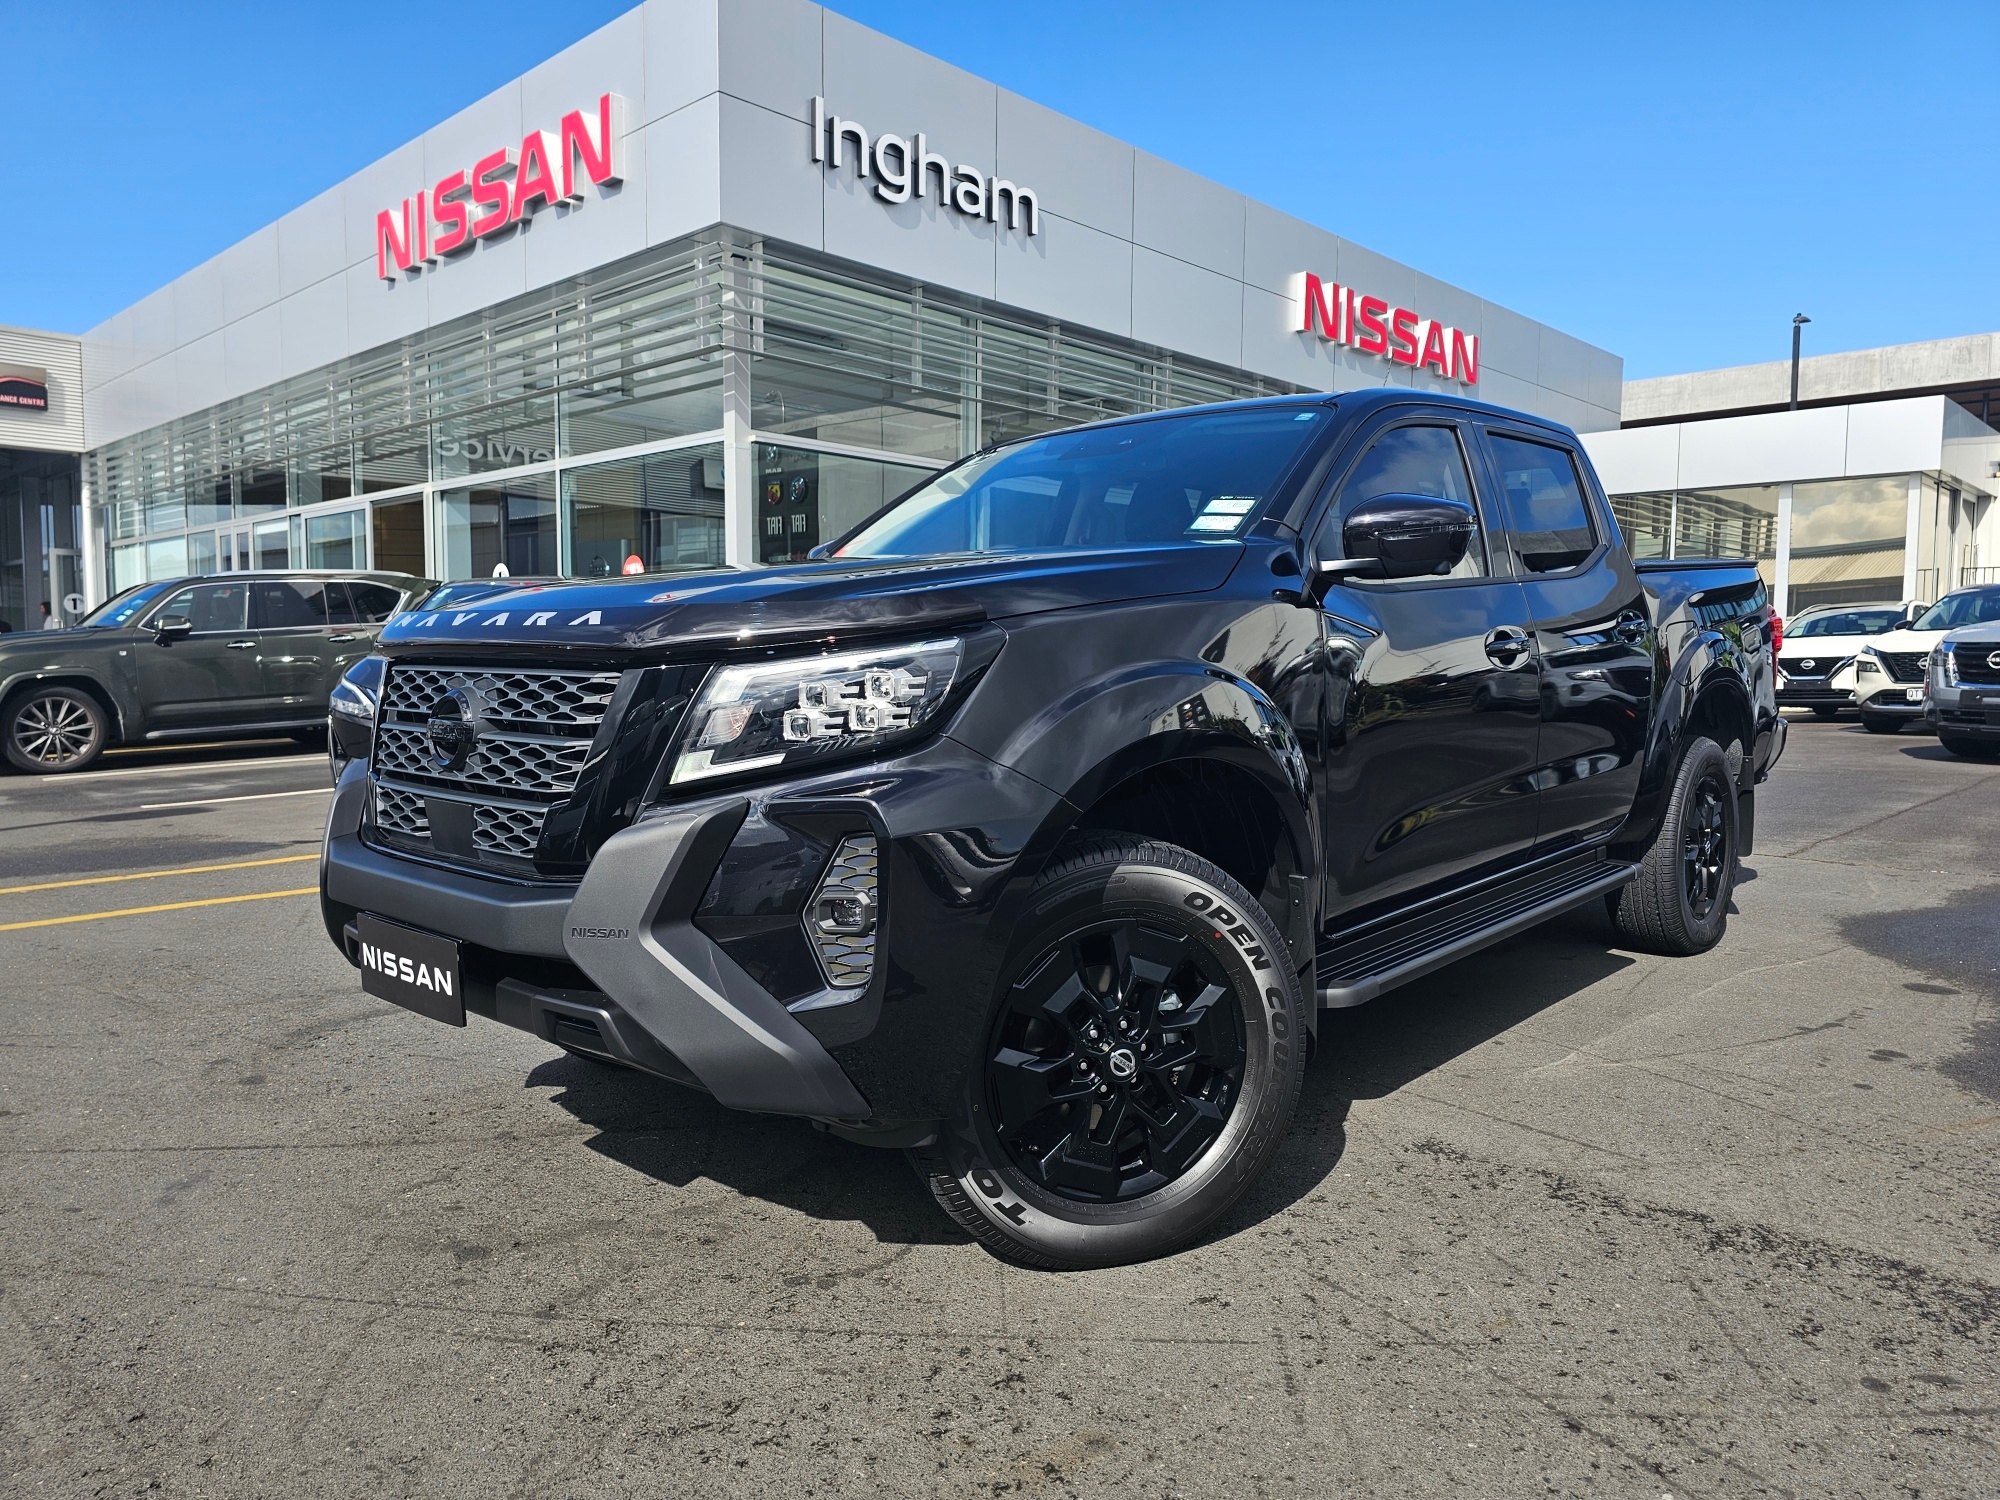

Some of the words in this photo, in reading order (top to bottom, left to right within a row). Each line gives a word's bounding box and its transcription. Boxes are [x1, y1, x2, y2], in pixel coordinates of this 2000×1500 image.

[376, 91, 624, 281] NISSAN
[811, 95, 1039, 236] Ingham
[1297, 271, 1479, 386] NISSAN
[19, 396, 46, 407] CENTRE
[394, 610, 603, 628] NAVARA
[571, 926, 629, 940] NISSAN
[1183, 891, 1272, 971] OPEN
[362, 942, 453, 997] NISSAN
